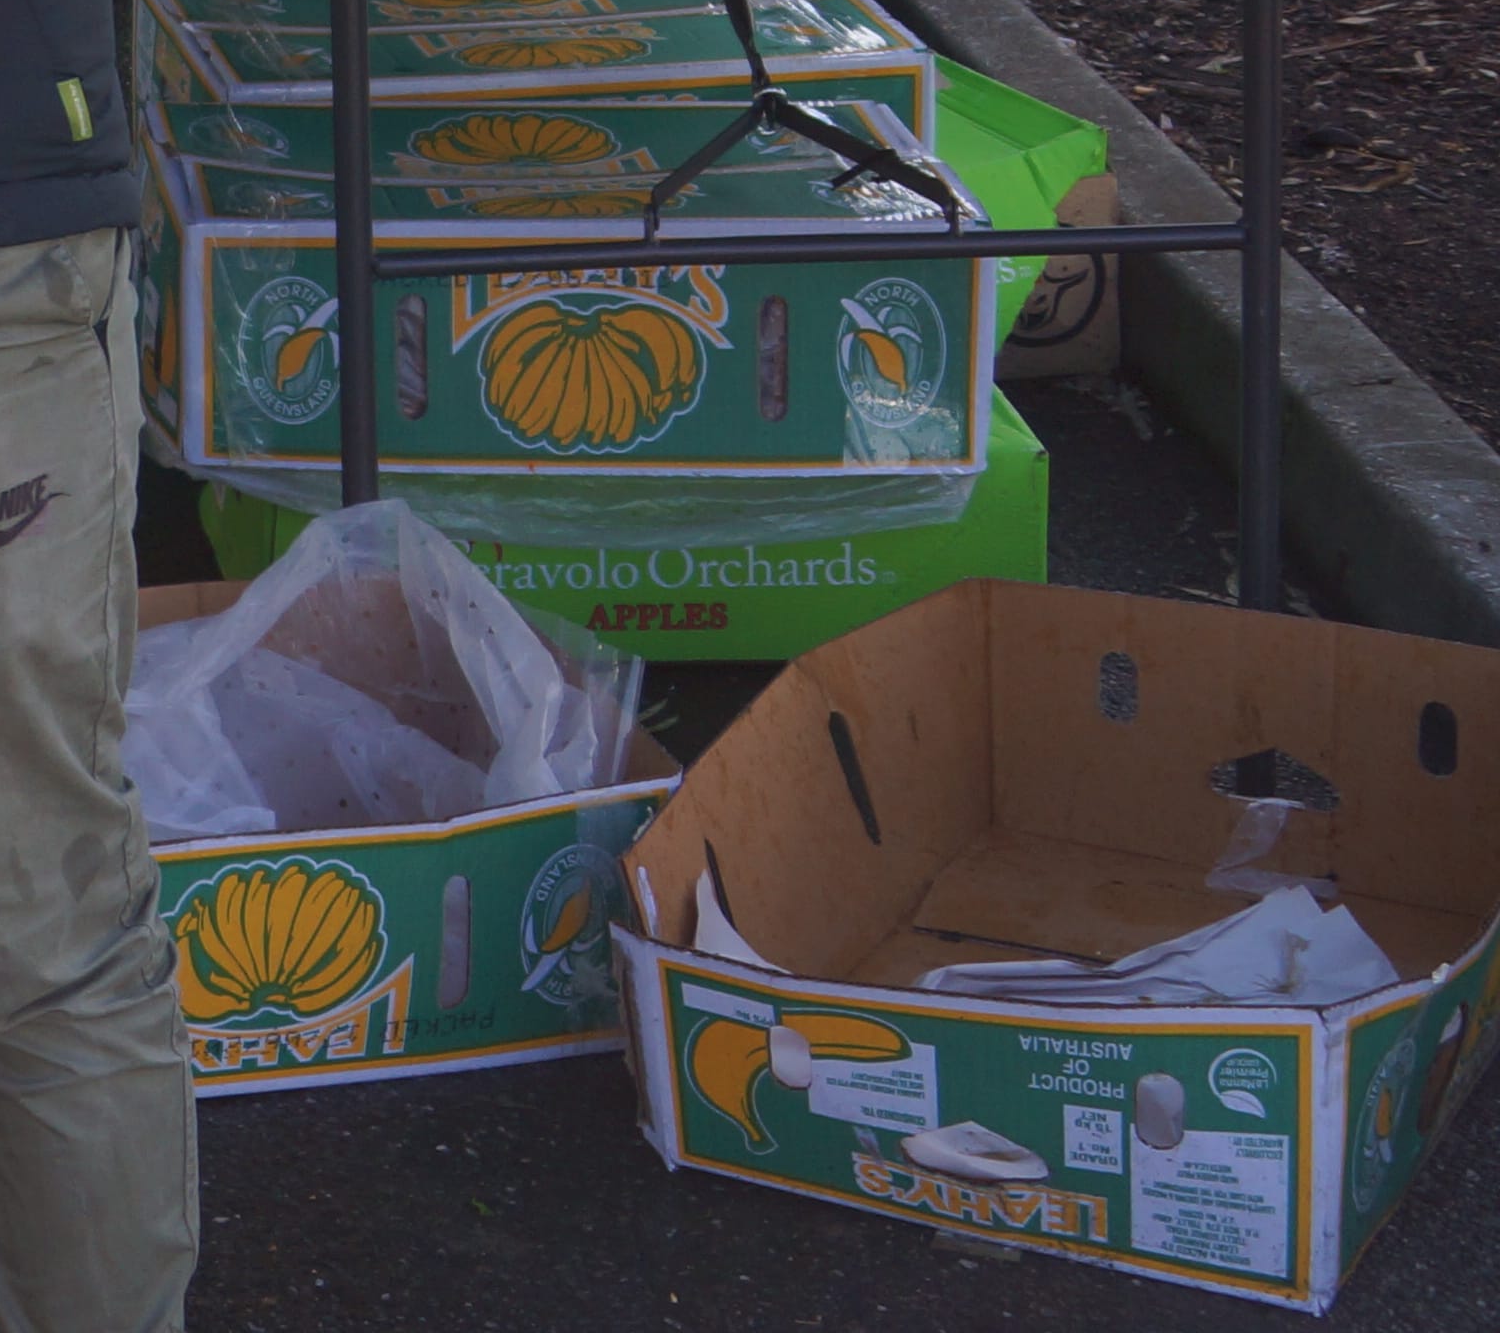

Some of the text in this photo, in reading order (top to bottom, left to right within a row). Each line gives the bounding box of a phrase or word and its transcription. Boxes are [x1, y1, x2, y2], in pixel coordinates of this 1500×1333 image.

[264, 284, 320, 306] NORTH
[863, 285, 921, 308] NORTH
[252, 375, 333, 417] QUEENSLAND
[647, 541, 877, 589] Orchards
[585, 601, 728, 632] APPLES
[1018, 1033, 1133, 1061] AUSTRALIA
[1061, 1057, 1091, 1076] OF
[1219, 1066, 1269, 1079] Premier
[1027, 1072, 1126, 1100] PRODUCT
[1219, 1077, 1269, 1090] LaManna
[1080, 1110, 1108, 1124] NET
[1069, 1152, 1119, 1167] GRADE
[851, 1151, 1109, 1244] LEAHY'S
